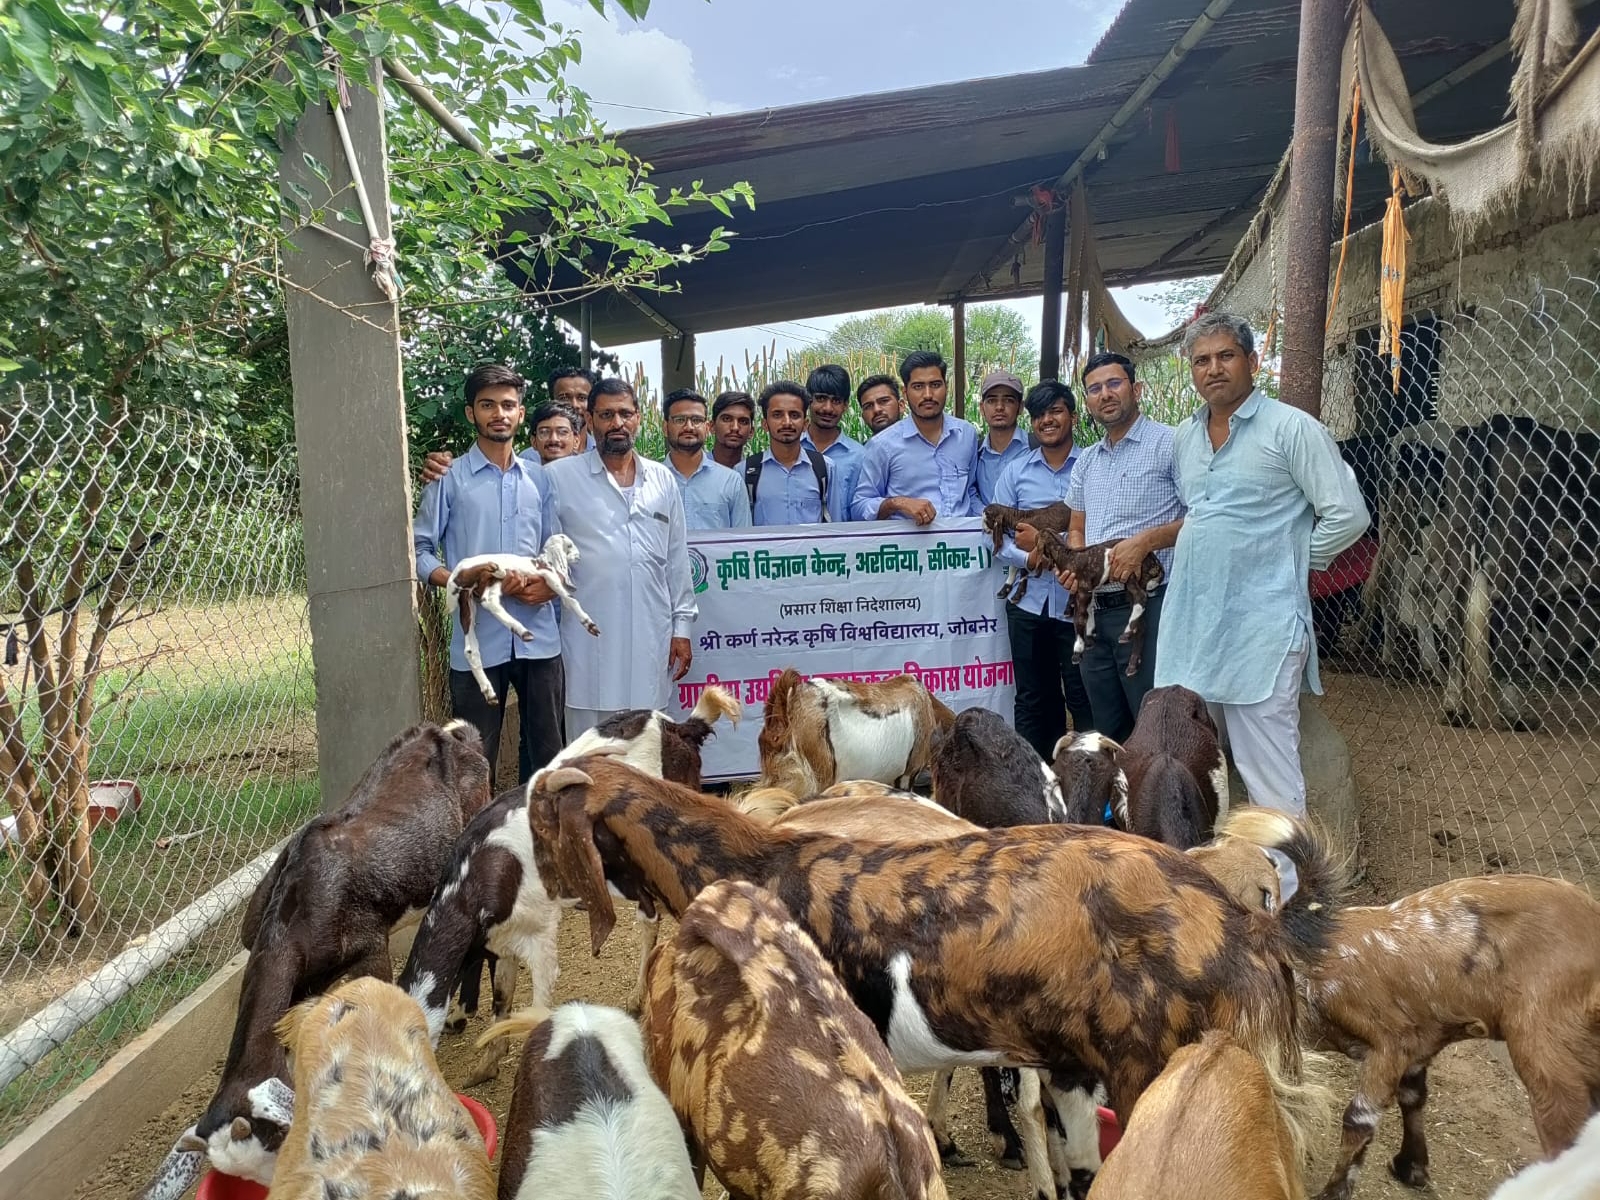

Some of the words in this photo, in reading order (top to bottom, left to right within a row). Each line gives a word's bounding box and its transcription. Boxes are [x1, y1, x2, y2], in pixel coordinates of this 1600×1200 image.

[716, 551, 750, 590] कृषि
[754, 550, 807, 580] विज्ञान
[810, 548, 850, 579] केन्द्र,
[856, 544, 923, 575] अरनिया,
[779, 603, 816, 619] (प्रसार
[819, 598, 853, 614] शिक्षा
[856, 596, 921, 613] निदेशालय)
[700, 631, 721, 650] श्री
[725, 628, 758, 648] कर्ण
[761, 627, 799, 646] नरेन्द्र
[803, 623, 837, 648] कृषि
[841, 621, 944, 642] विश्वविद्यालय,
[947, 615, 998, 635] जोबनेर
[963, 656, 1013, 689] योजना
